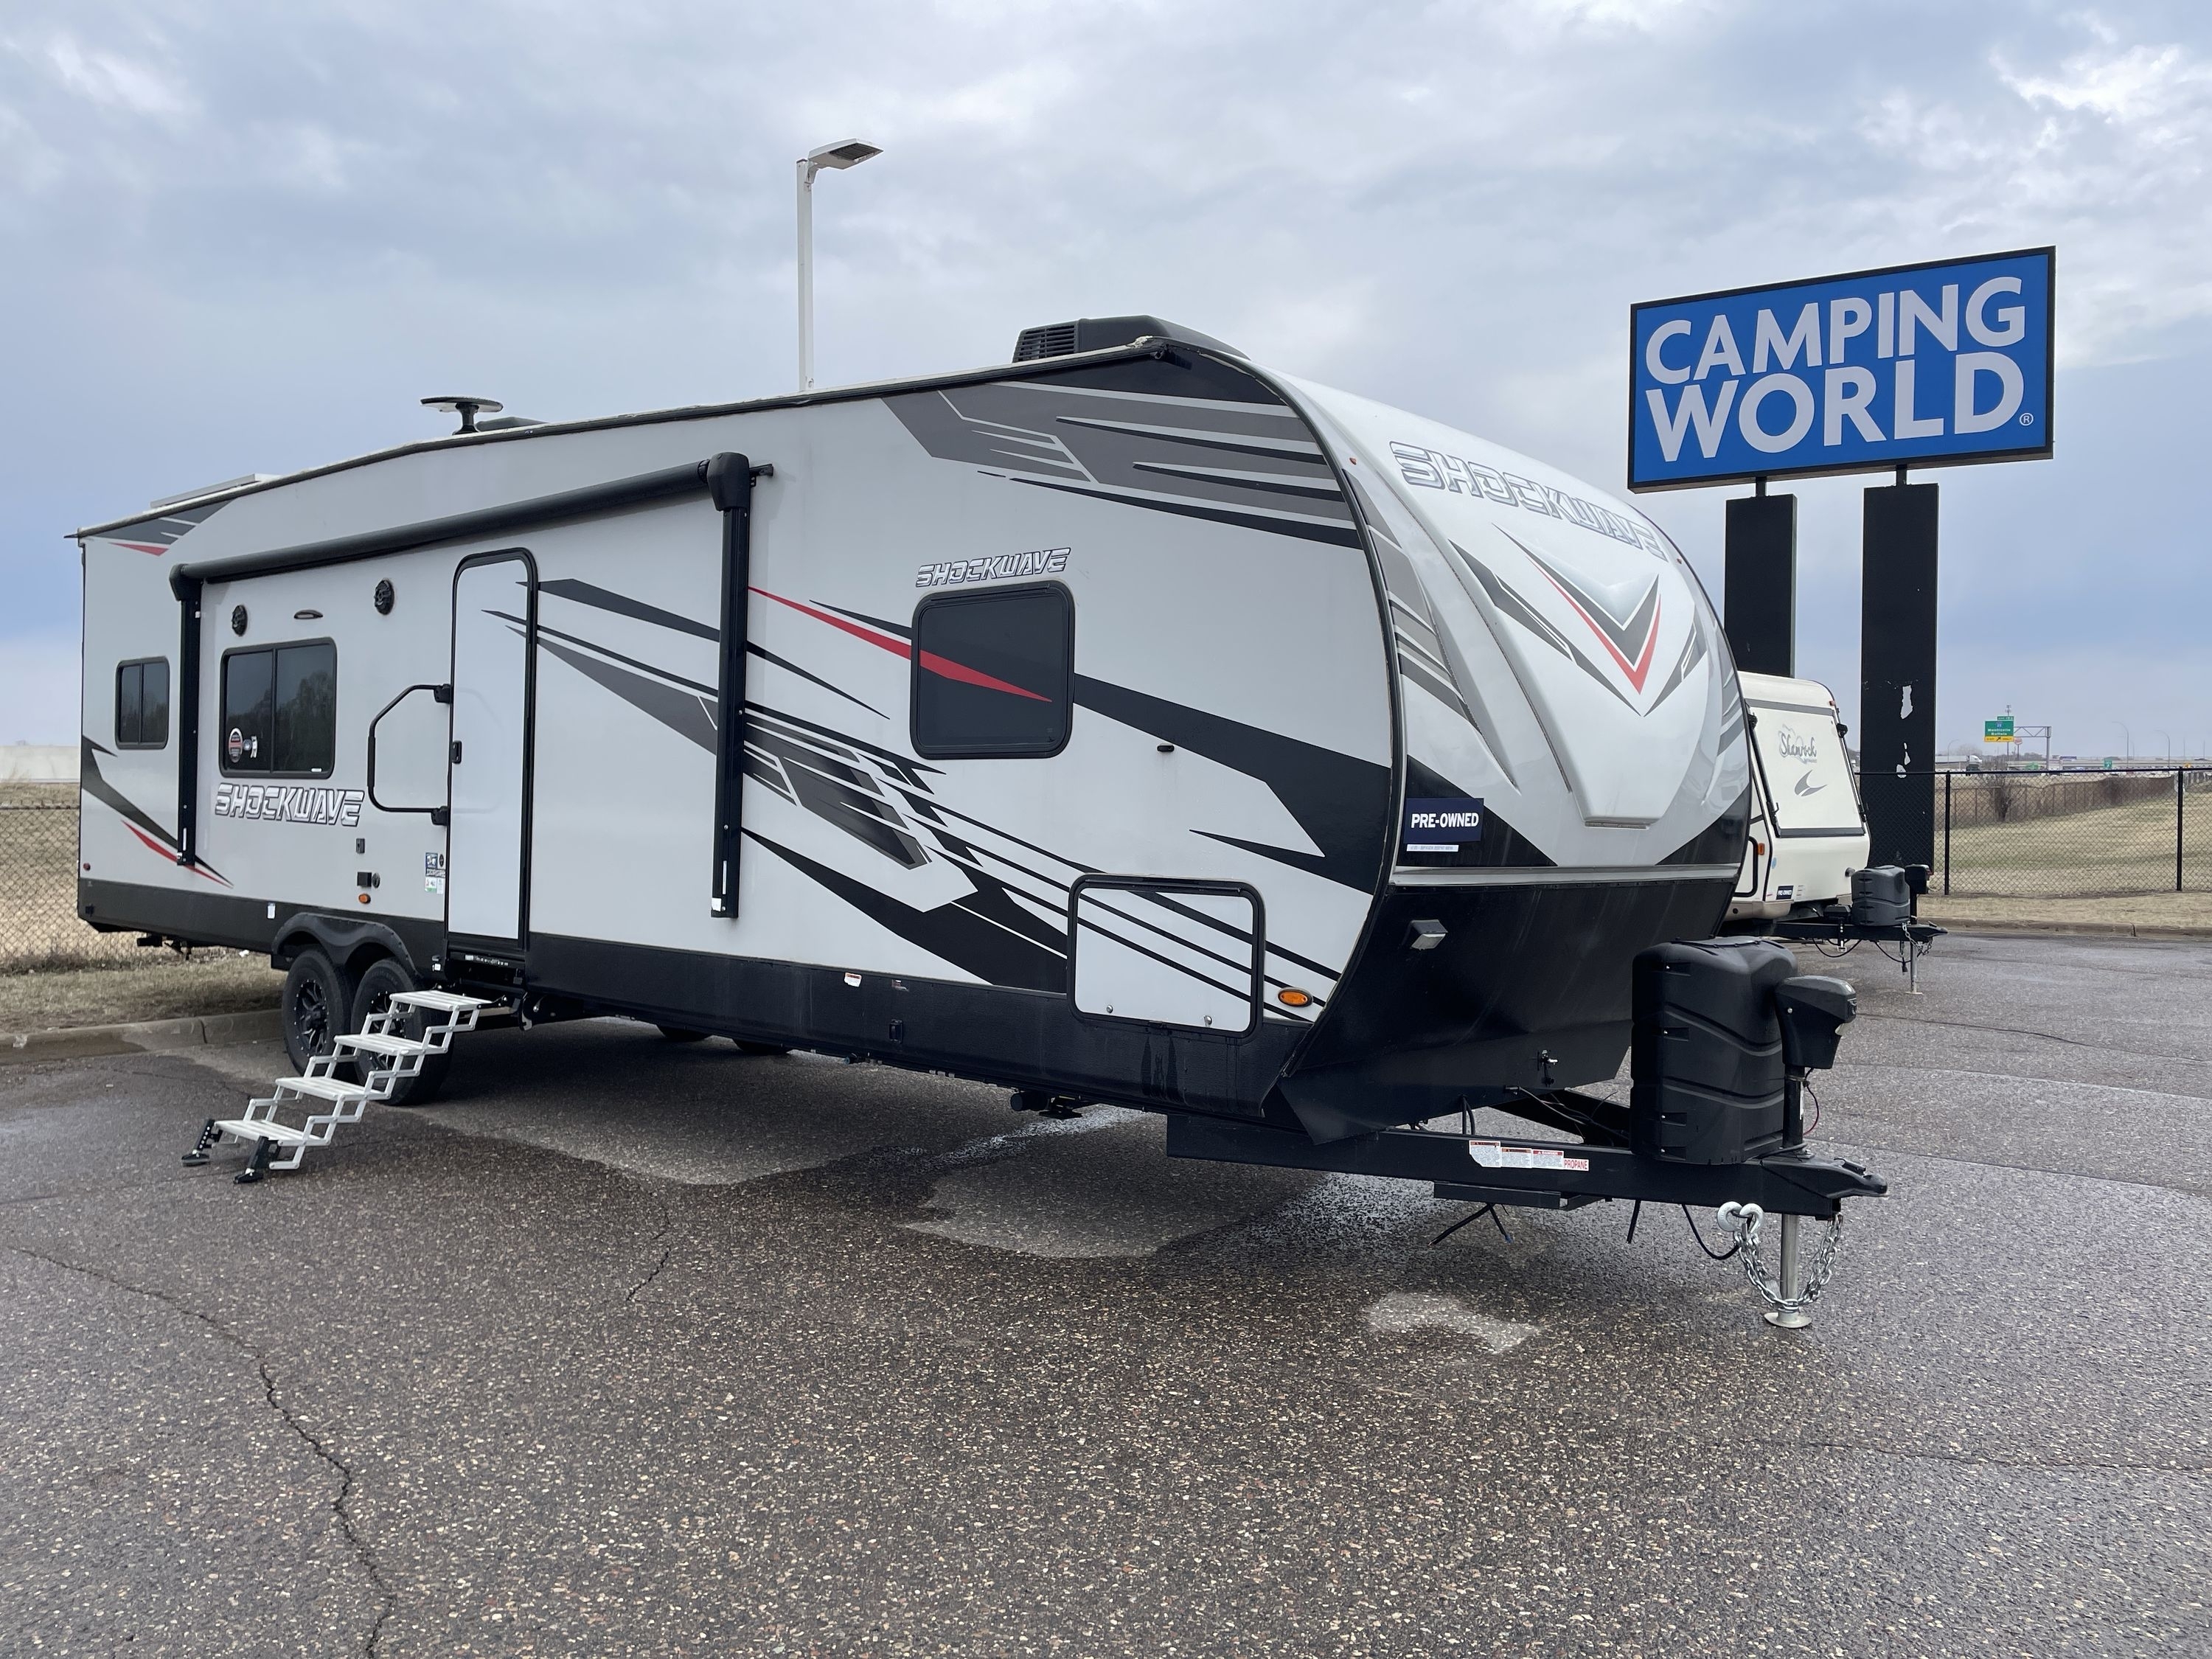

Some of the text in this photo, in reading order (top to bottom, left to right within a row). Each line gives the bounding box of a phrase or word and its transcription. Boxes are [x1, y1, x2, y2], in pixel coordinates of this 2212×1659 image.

[1646, 276, 2025, 384] CAMPING
[1646, 352, 2024, 462] WORLD
[1389, 441, 1669, 562] SHOCKWAVE
[916, 547, 1071, 588] SHOCKWAVE
[215, 782, 365, 827] SHOCKWAVE
[1411, 813, 1479, 828] PRE-OWNED
[1564, 1159, 1587, 1170] PROPANE
